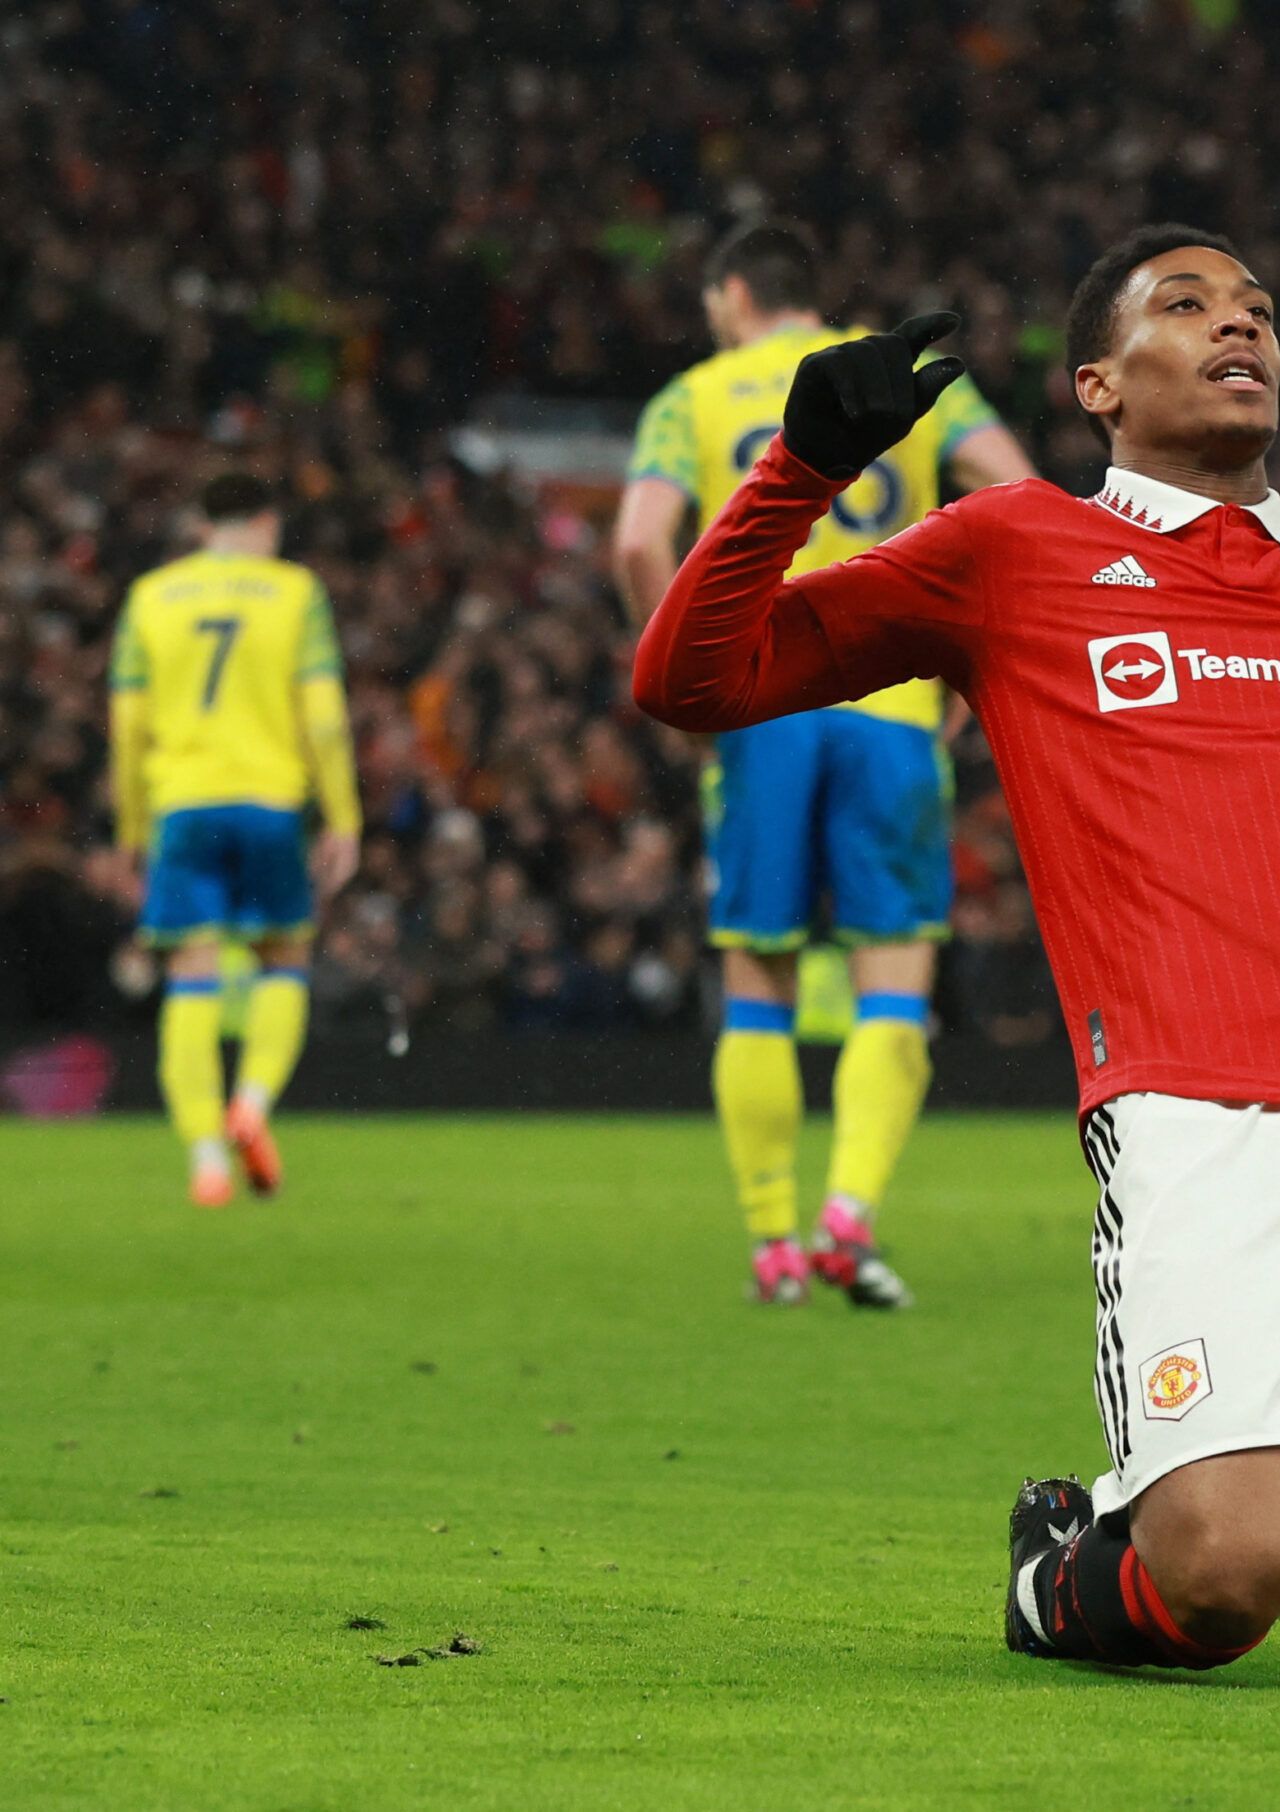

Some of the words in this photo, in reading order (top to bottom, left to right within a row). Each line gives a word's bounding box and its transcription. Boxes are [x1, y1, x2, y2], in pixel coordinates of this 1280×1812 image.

[1091, 573, 1156, 588] adidas
[195, 617, 242, 711] 7
[1150, 1357, 1195, 1386] MANCHESTER
[1160, 1390, 1192, 1407] UNITED
